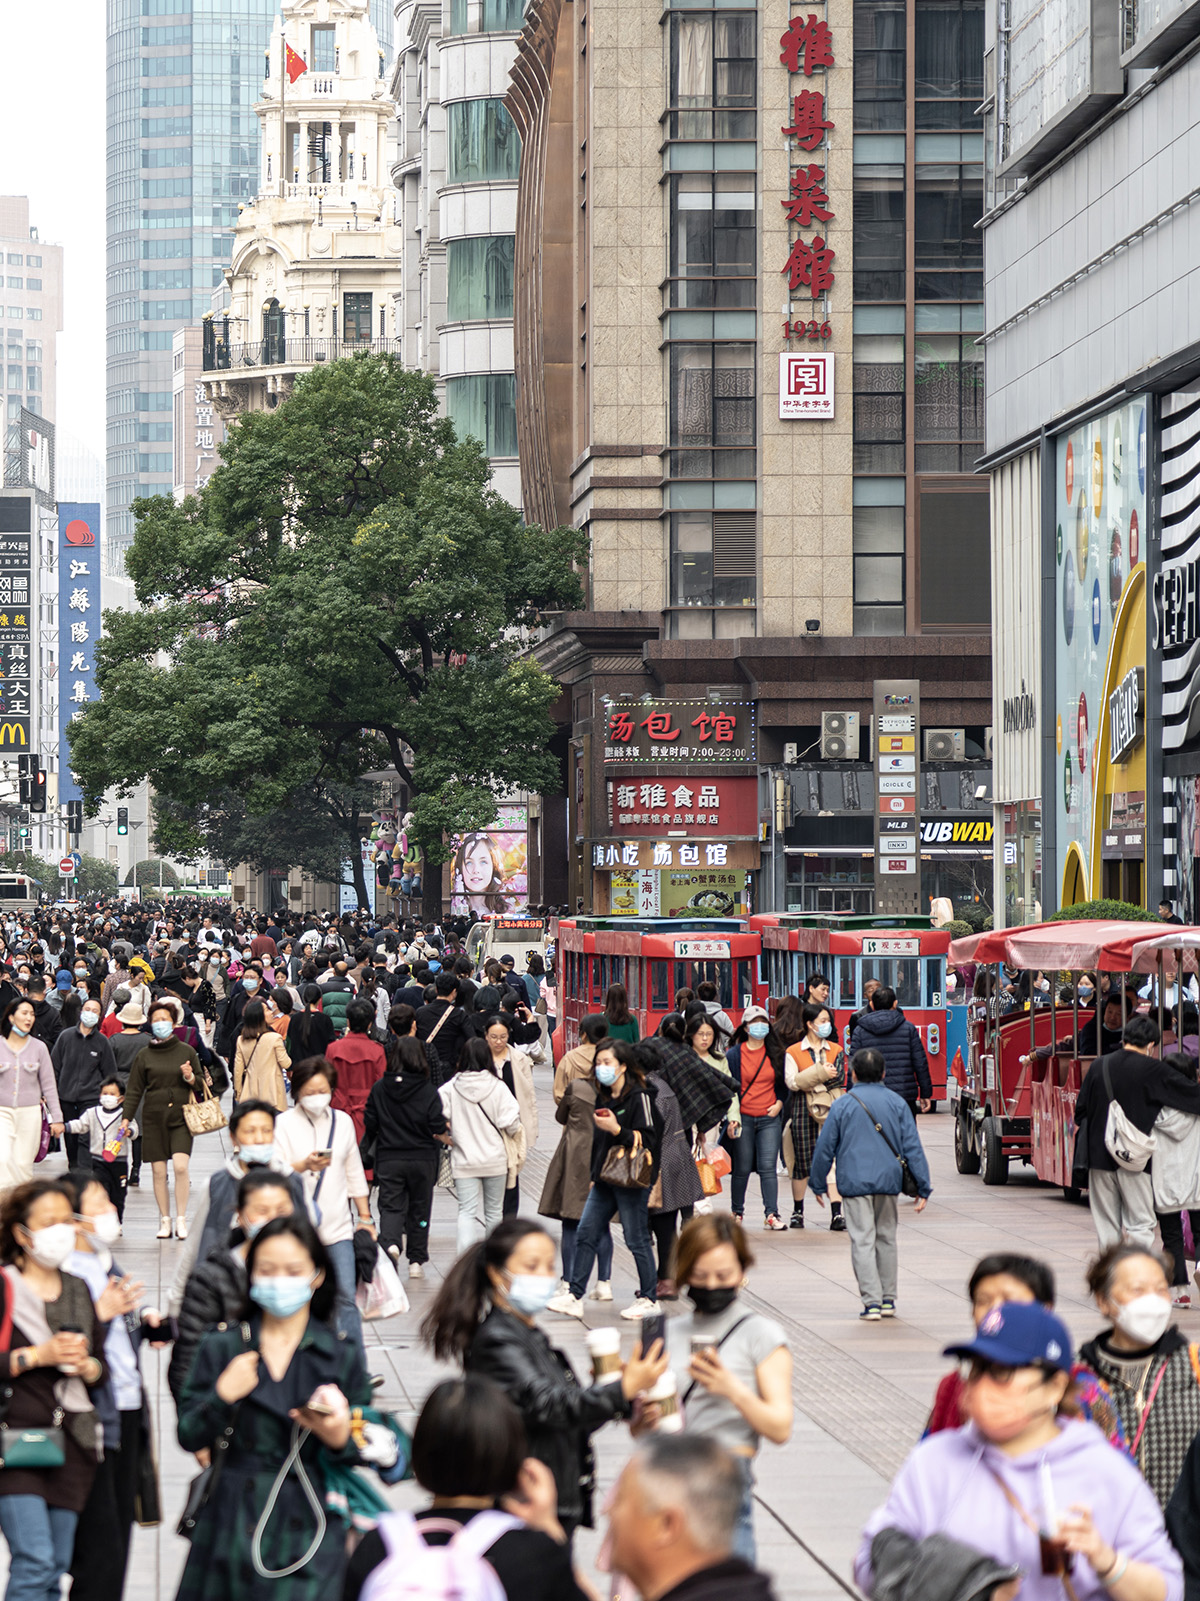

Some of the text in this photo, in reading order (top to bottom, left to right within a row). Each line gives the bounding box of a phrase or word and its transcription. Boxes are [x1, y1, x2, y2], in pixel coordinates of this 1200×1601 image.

[781, 320, 833, 339] 1926
[7, 682, 29, 714] 大王
[1003, 693, 1035, 734] PANDORA
[609, 710, 737, 742] 汤包馆
[650, 746, 689, 757] 营业时间
[617, 783, 720, 809] 新雅食品
[653, 843, 728, 866] 汤包馆
[745, 996, 751, 1006] 7
[934, 993, 941, 1005] 3
